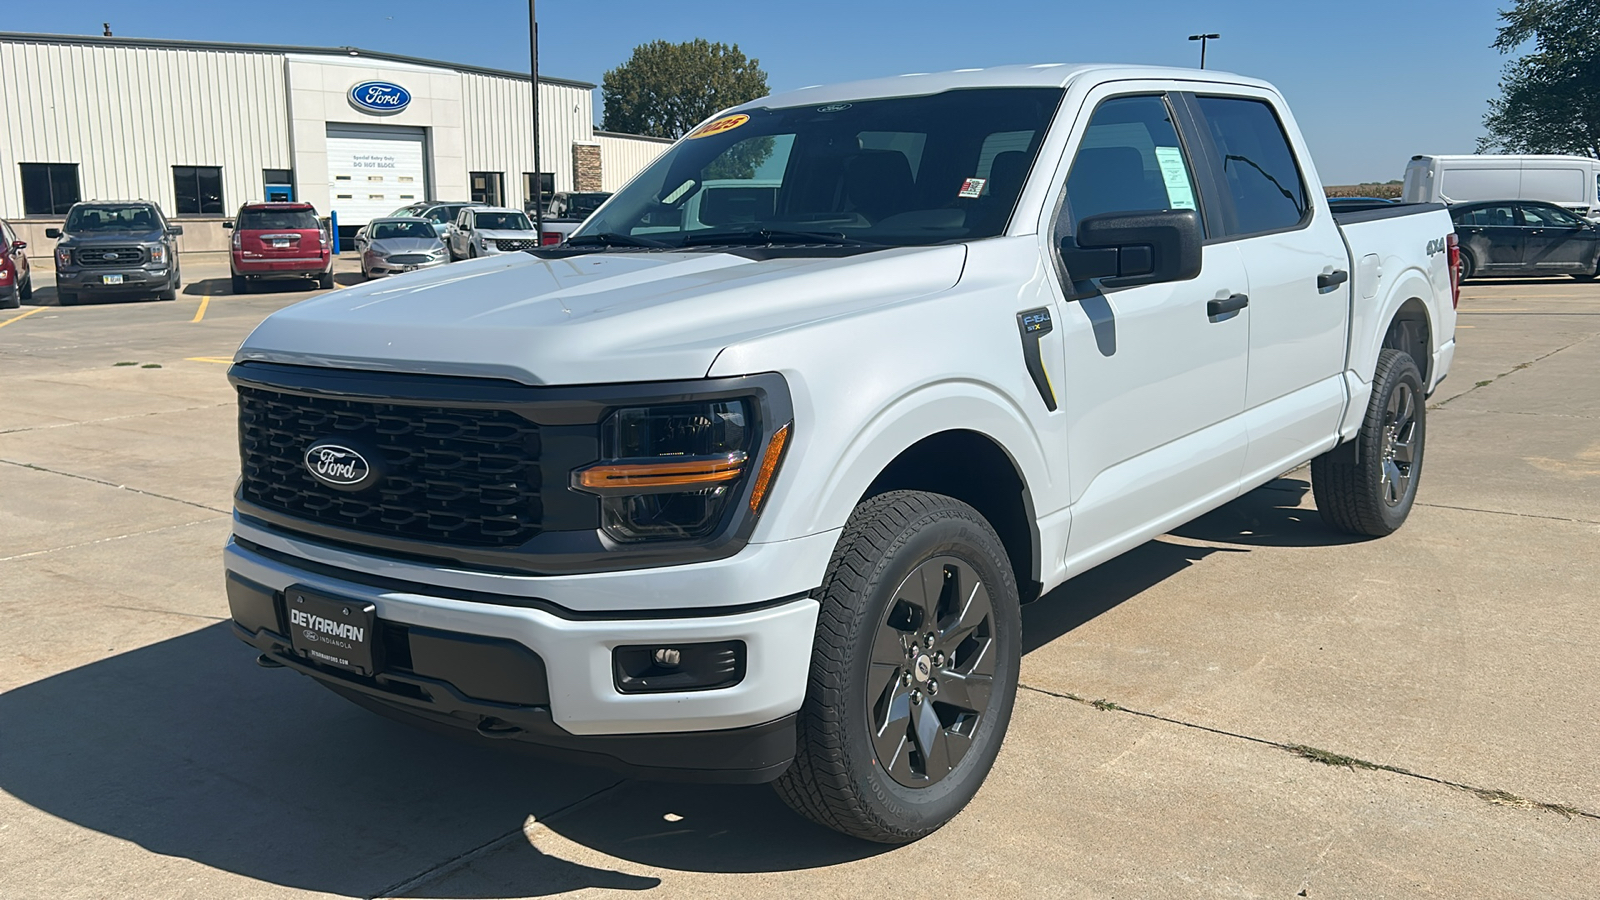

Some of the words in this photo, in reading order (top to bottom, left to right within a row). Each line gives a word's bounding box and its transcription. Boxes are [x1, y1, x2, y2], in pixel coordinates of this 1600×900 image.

[365, 86, 400, 105] Ford
[691, 117, 745, 138] 2025
[317, 449, 356, 479] Ford
[291, 608, 364, 643] DEYARMAN
[320, 636, 352, 650] INDIANOLA
